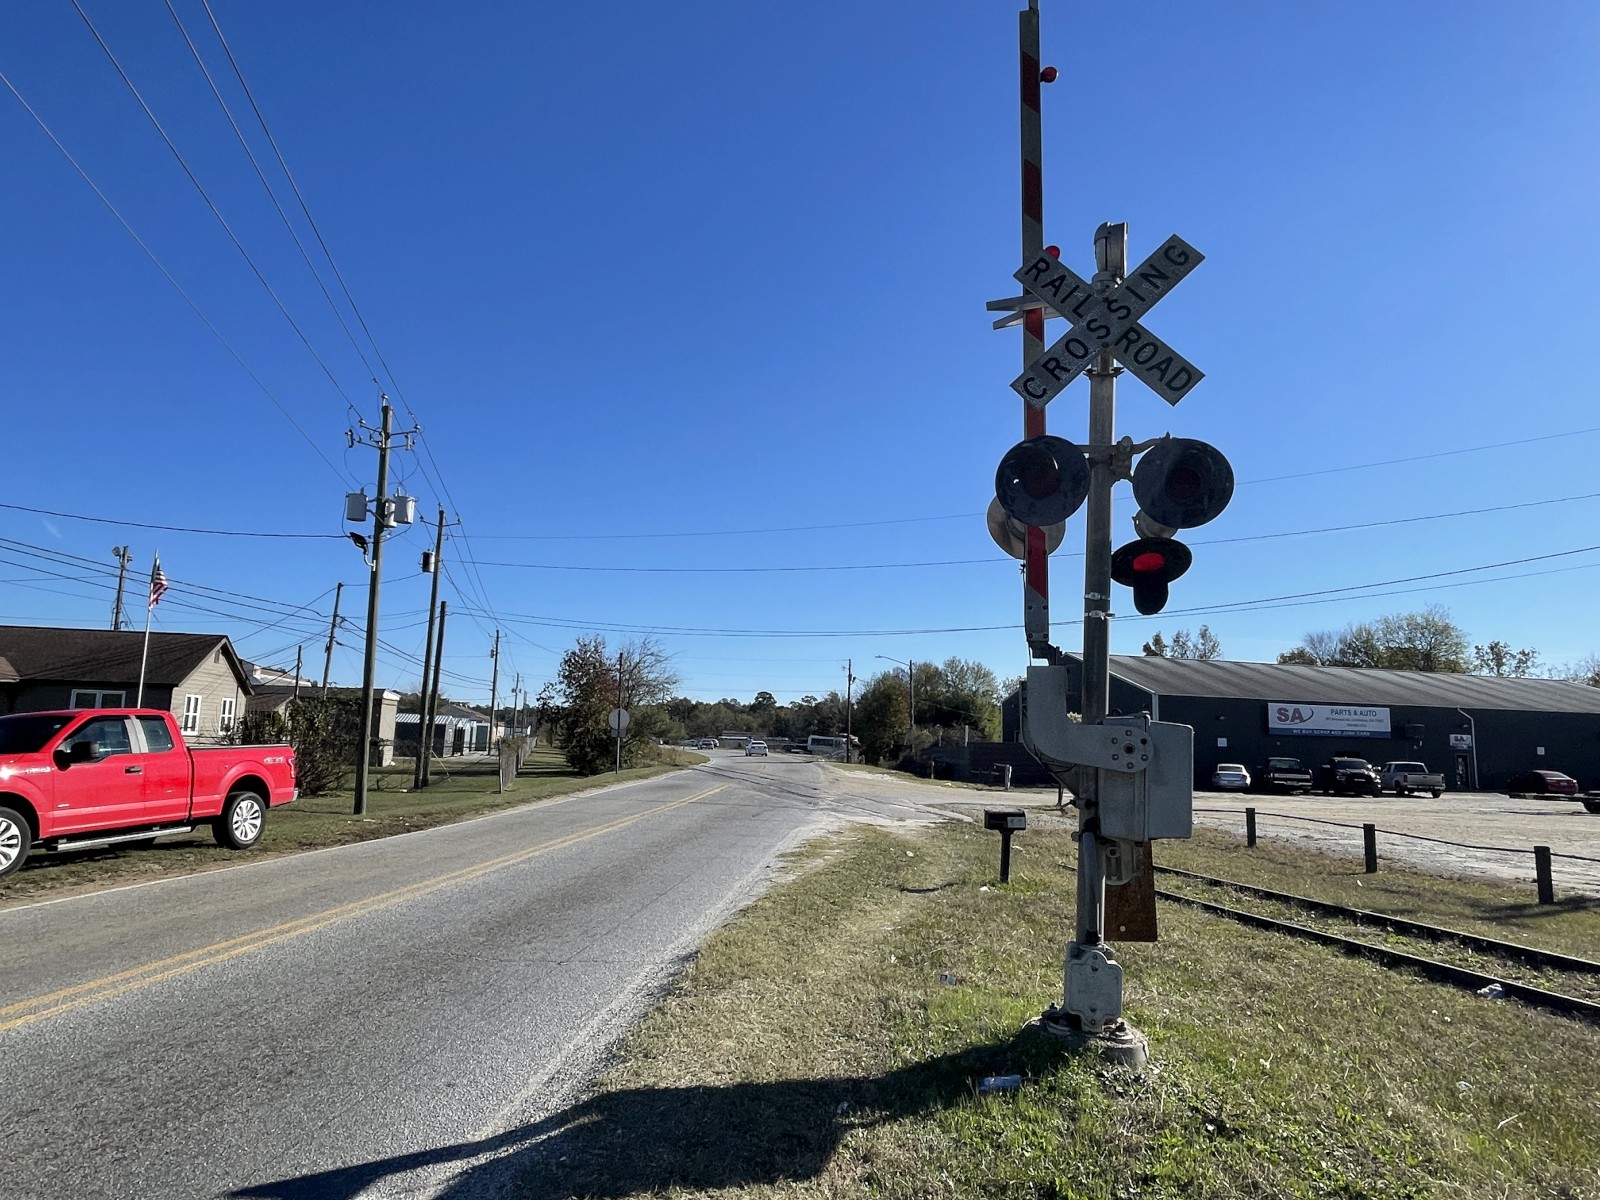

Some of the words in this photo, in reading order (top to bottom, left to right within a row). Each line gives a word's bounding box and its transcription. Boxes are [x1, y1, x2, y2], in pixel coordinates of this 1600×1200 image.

[1022, 244, 1190, 400] CROSSING
[1024, 257, 1092, 319] RAIL
[1114, 327, 1193, 392] ROAD
[1276, 707, 1305, 722] SA
[1330, 708, 1352, 716] PARTS
